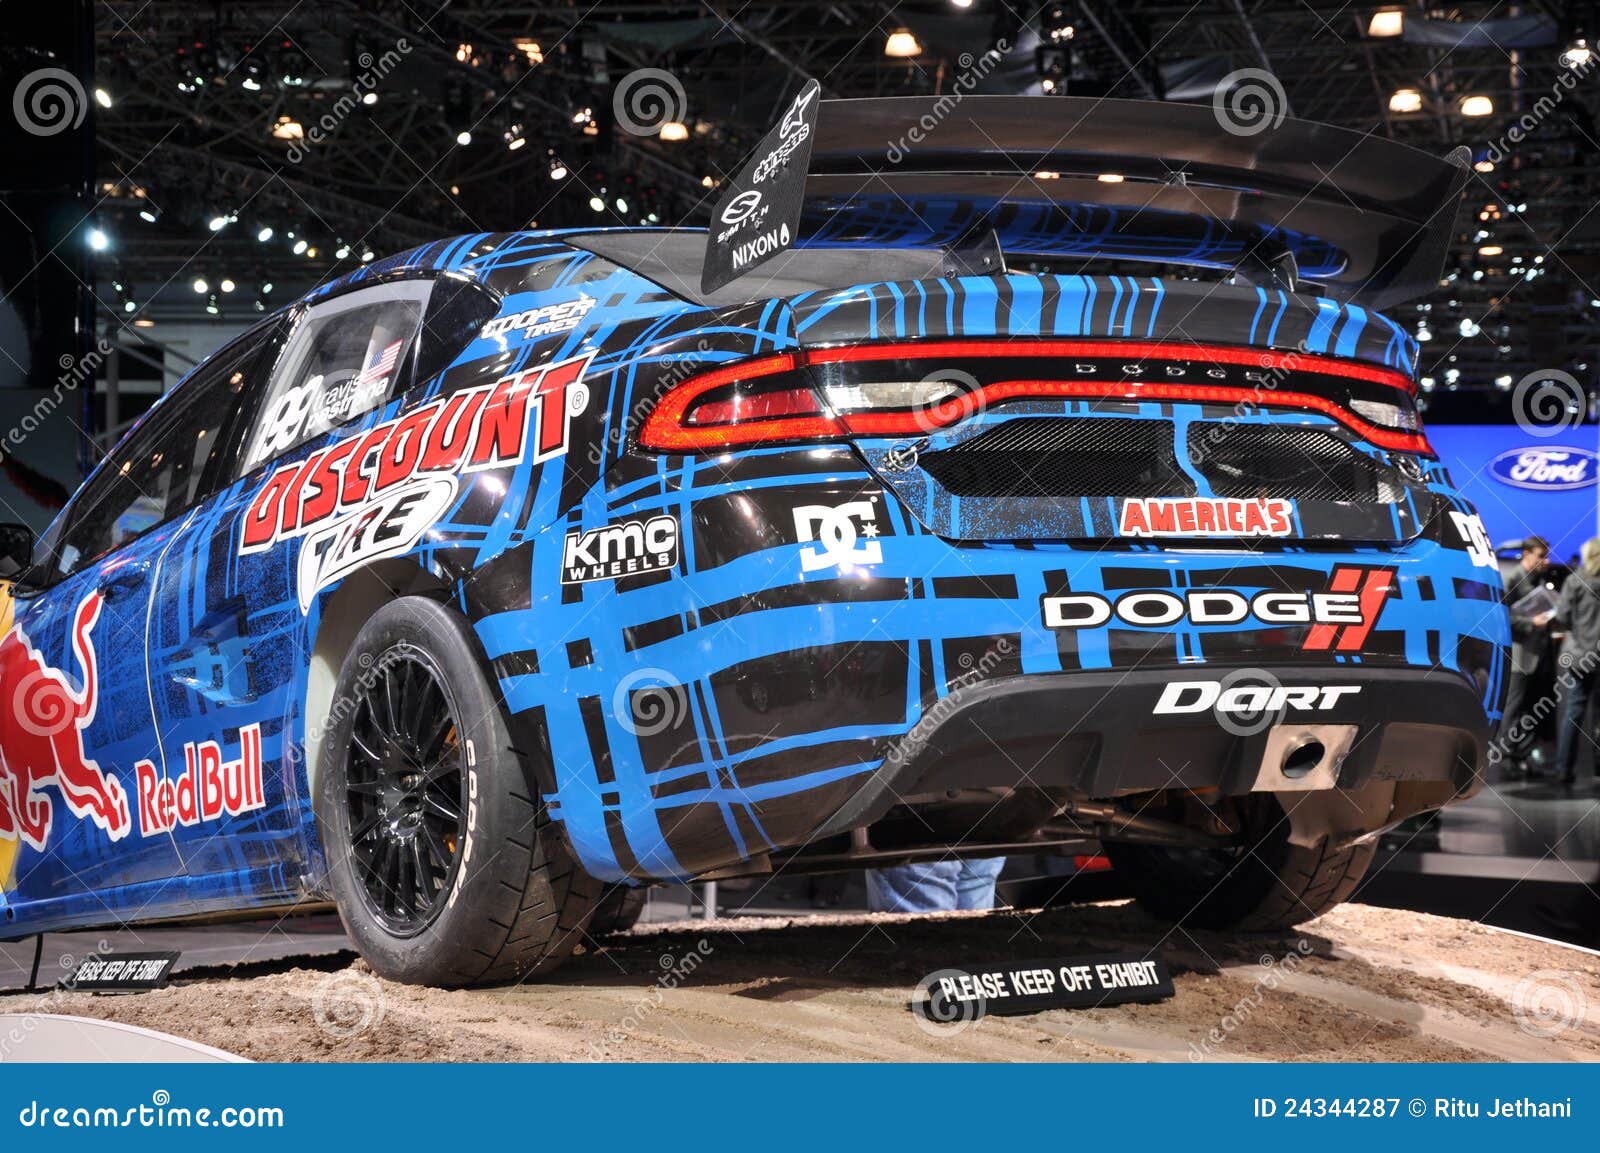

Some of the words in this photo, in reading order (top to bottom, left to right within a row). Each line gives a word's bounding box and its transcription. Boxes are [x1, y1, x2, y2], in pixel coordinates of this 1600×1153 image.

[732, 229, 778, 269] NIXON
[480, 297, 597, 339] COOPER
[523, 315, 583, 340] TIRES
[1075, 362, 1264, 381] DODGE
[240, 350, 595, 554] DISCOUNT
[1510, 451, 1588, 482] Ford
[1120, 498, 1292, 537] AMERICA'S
[570, 553, 669, 581] WHEELS
[1045, 592, 1362, 628] DODGE
[939, 972, 1009, 1003] PLEASE
[1009, 969, 1055, 996] KEEP
[1060, 966, 1094, 992] OFF
[1096, 961, 1160, 989] EXHIBIT
